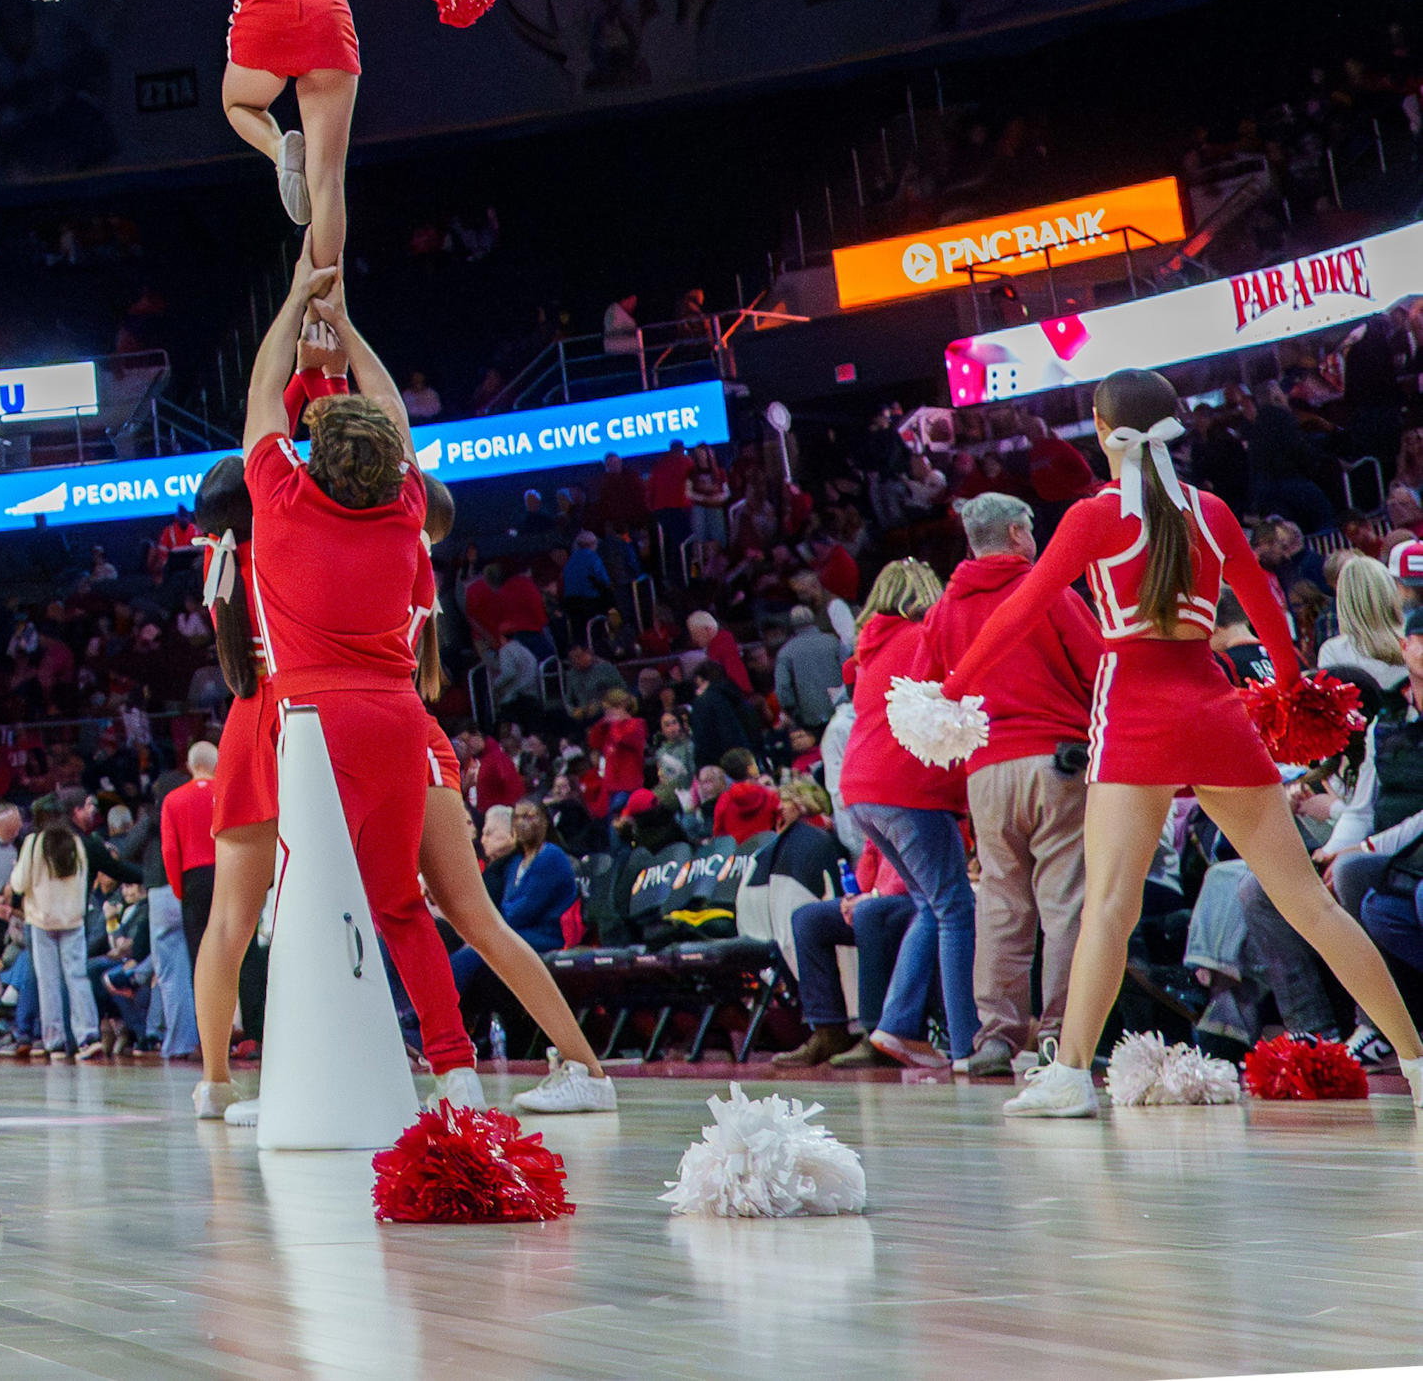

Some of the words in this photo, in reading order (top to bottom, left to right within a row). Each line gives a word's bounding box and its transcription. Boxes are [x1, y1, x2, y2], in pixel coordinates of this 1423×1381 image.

[938, 230, 1013, 275] PNC
[1011, 208, 1111, 260] BANK
[447, 432, 531, 465] PEORIA
[538, 424, 600, 454] CIVIC
[607, 409, 695, 448] CENTER
[70, 478, 160, 509] PEORIA
[166, 473, 206, 501] CIV
